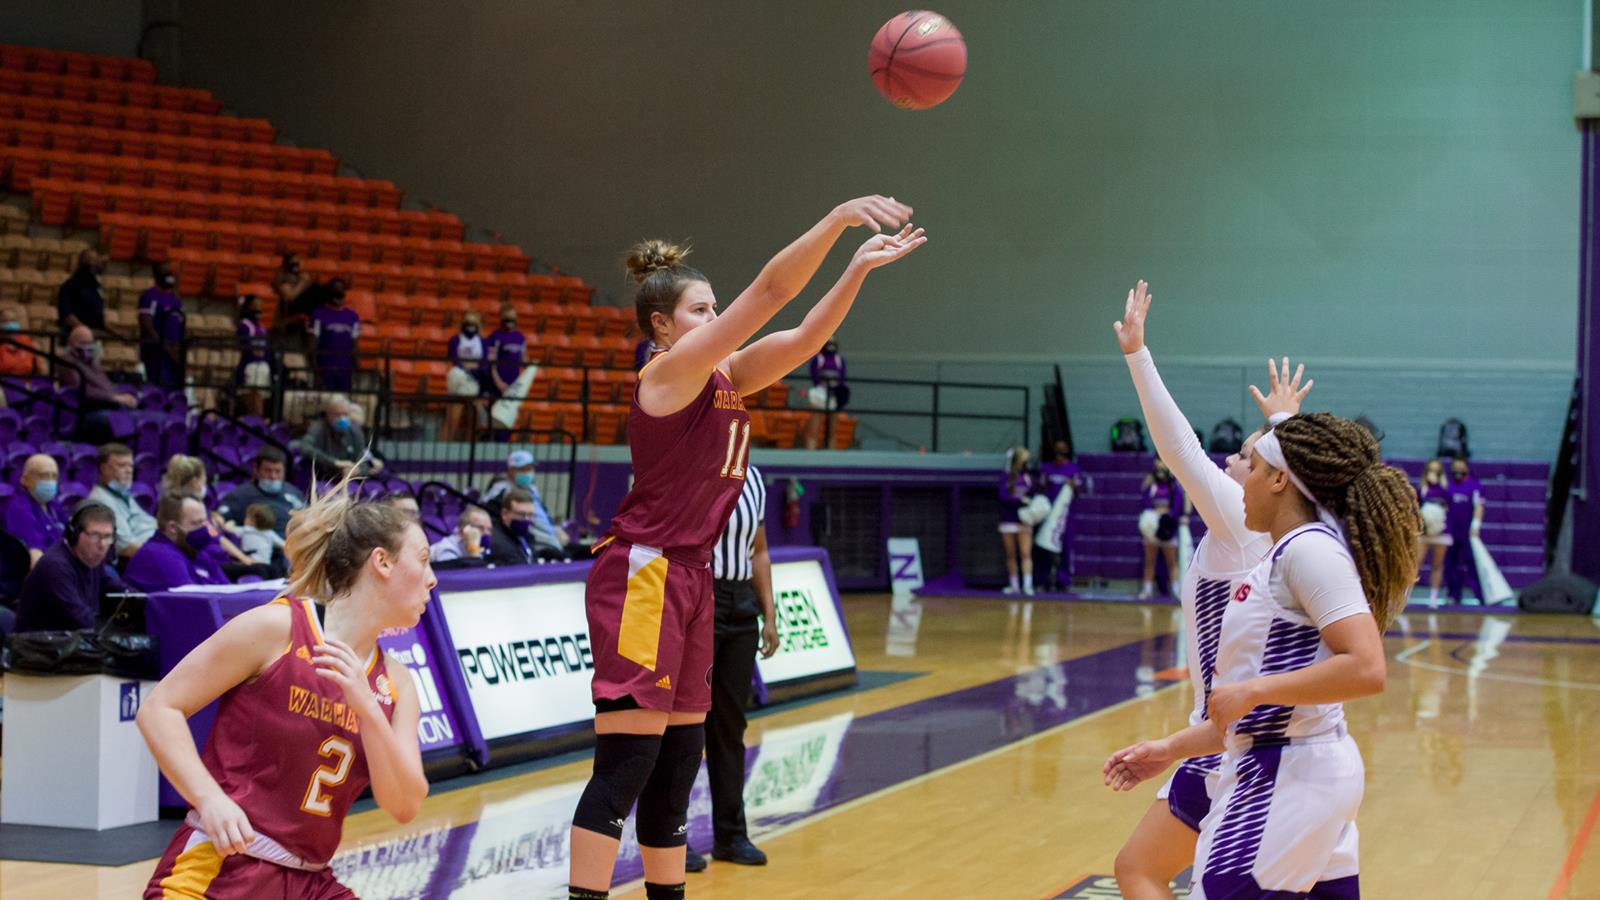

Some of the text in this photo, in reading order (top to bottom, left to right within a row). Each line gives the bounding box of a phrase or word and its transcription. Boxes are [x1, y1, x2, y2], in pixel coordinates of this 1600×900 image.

[720, 419, 750, 480] 11
[457, 633, 594, 689] POWERADE
[288, 685, 359, 734] WARHA
[300, 735, 357, 817] 2
